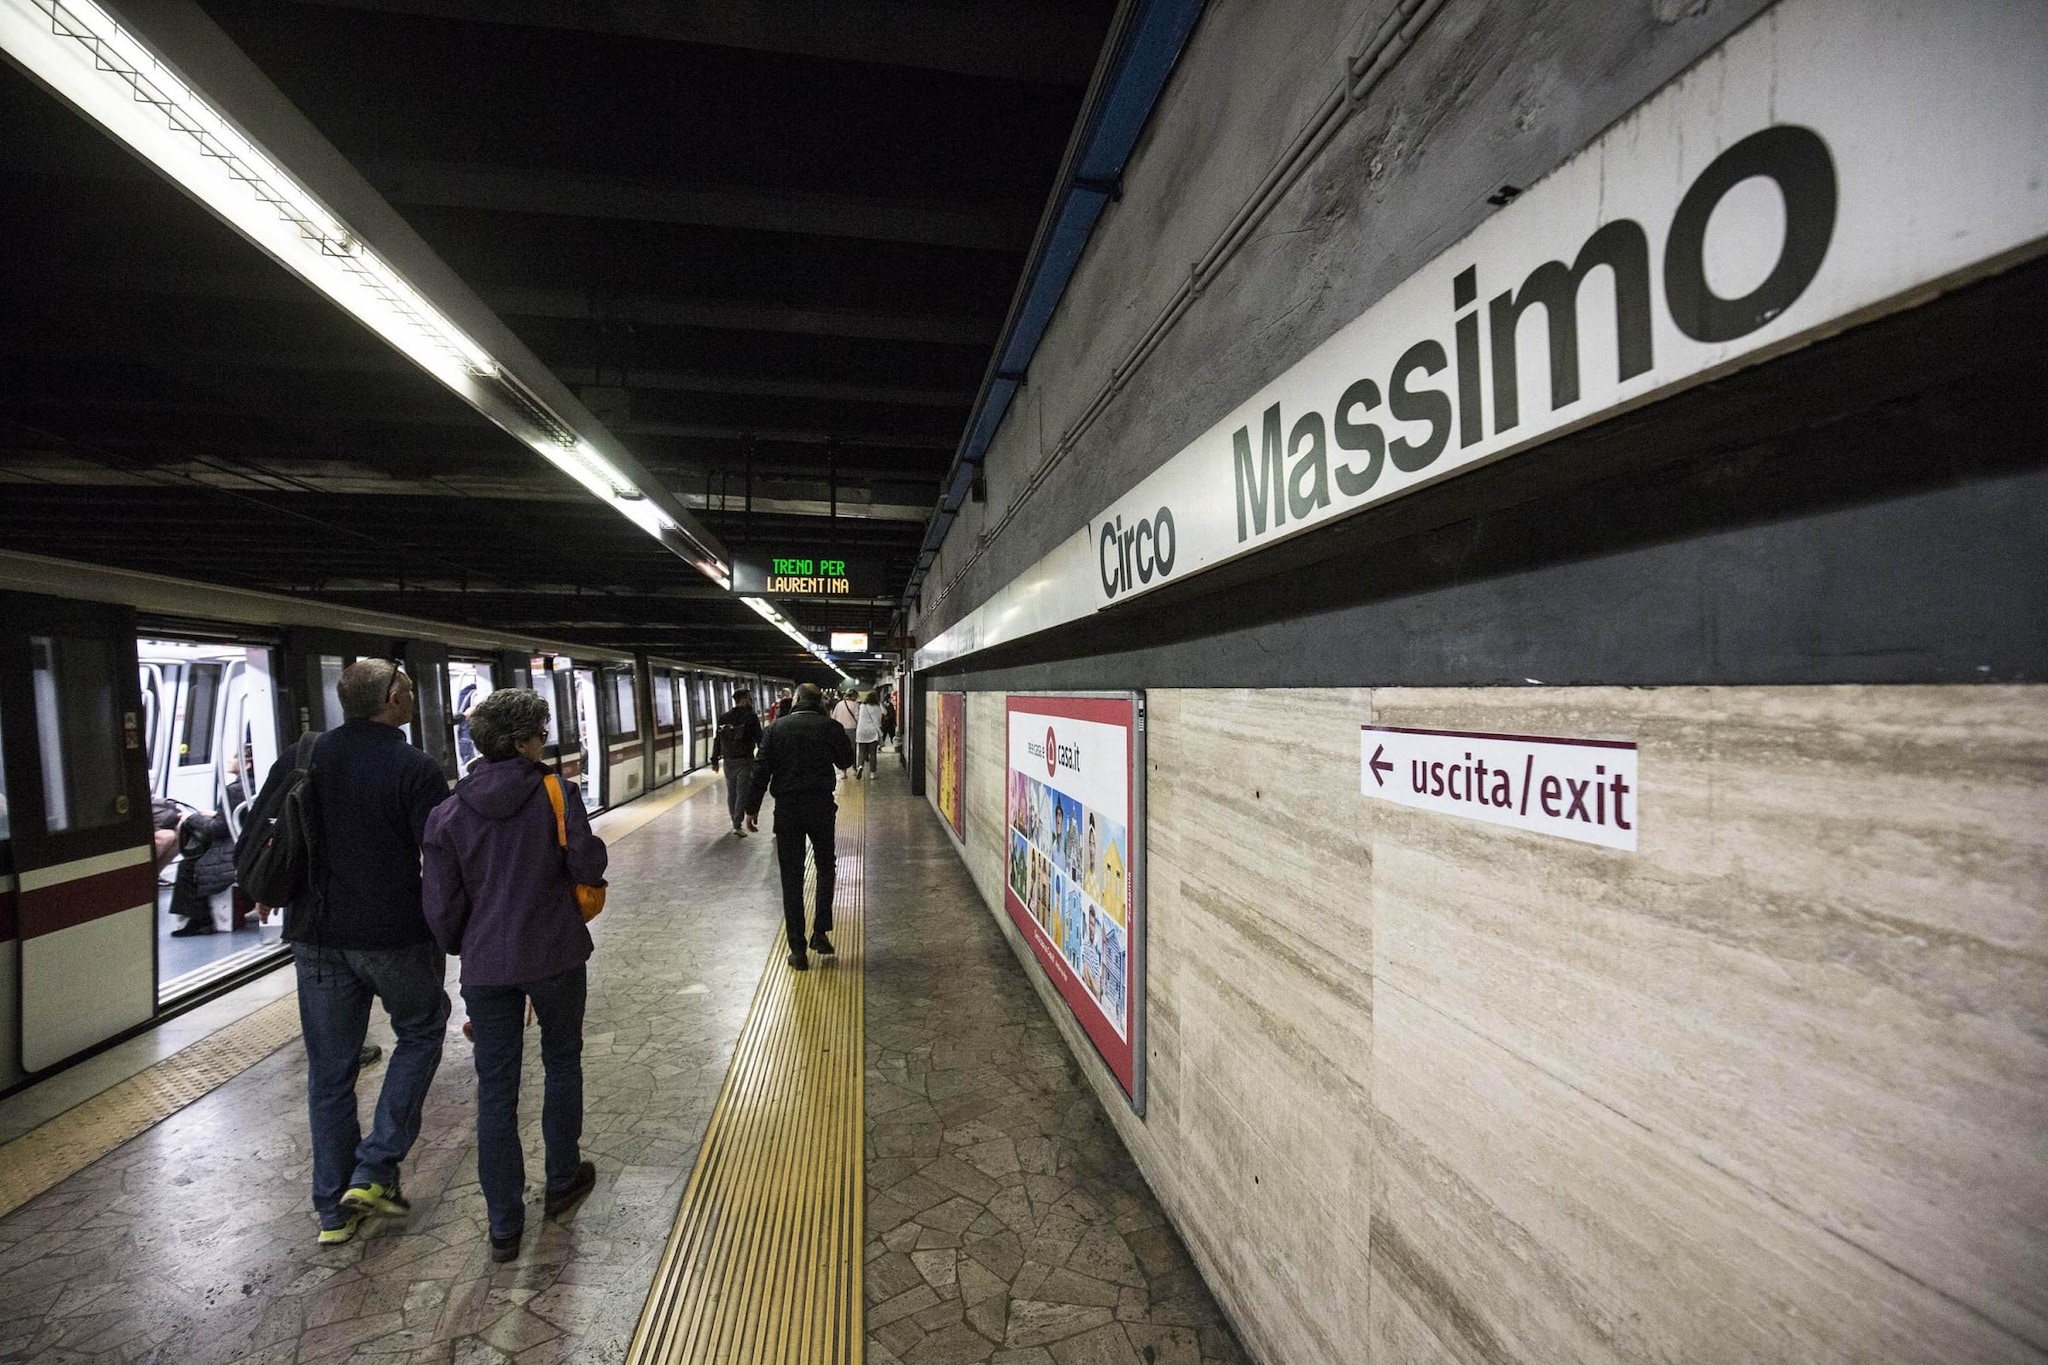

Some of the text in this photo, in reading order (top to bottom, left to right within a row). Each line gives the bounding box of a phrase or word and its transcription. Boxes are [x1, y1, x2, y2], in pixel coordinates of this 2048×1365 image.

[1100, 124, 1838, 598] Circo Massimo
[772, 559, 846, 576] TRENO PER
[766, 576, 849, 593] LAURENTINA
[1057, 742, 1080, 772] casa.it
[1411, 752, 1632, 830] uscita/exit
